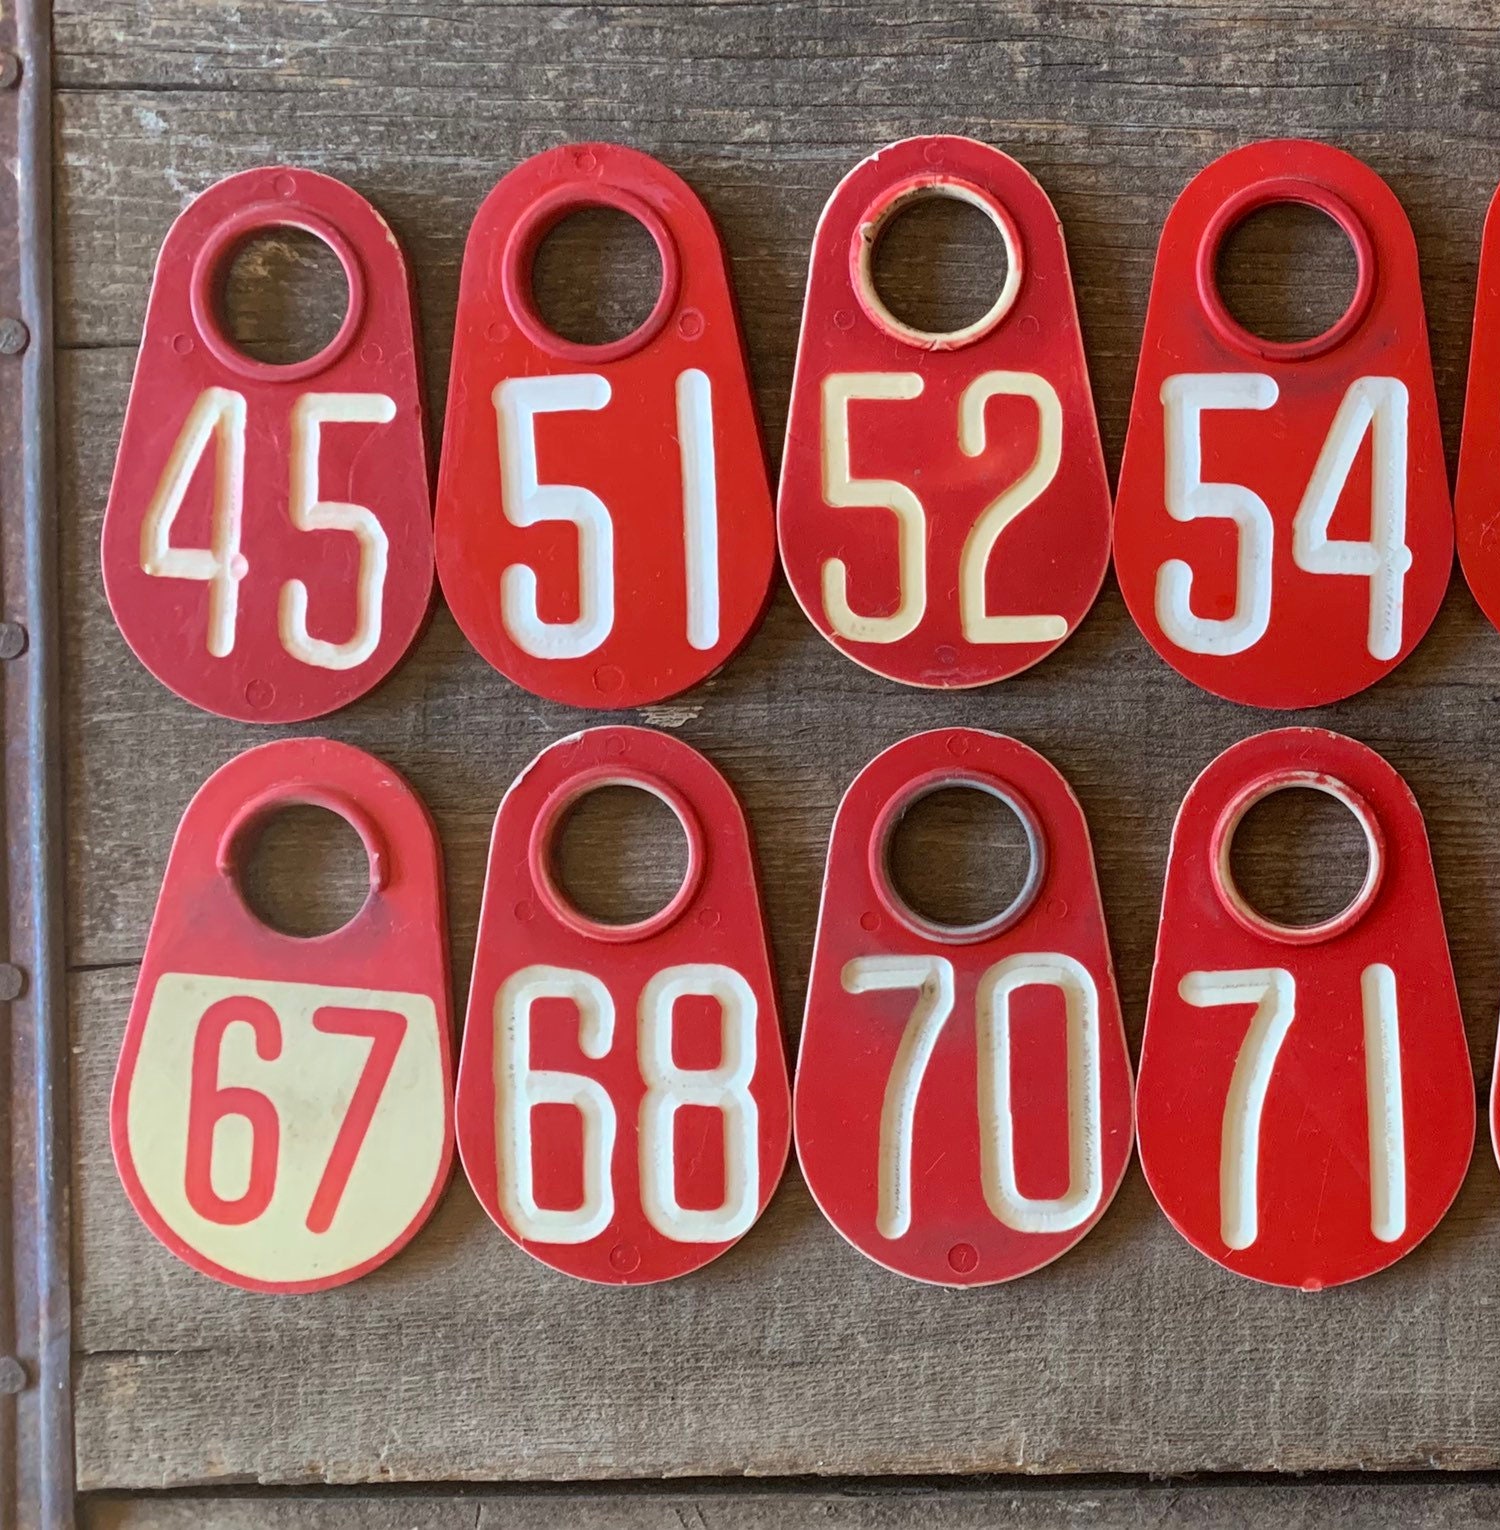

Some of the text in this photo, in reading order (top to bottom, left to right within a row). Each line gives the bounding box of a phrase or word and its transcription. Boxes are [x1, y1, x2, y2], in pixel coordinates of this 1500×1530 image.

[140, 386, 397, 671] 45
[491, 368, 720, 660] 51
[821, 370, 1068, 643] 52
[1154, 373, 1412, 661] 54
[184, 995, 408, 1234] 67
[493, 963, 758, 1244] 68
[841, 952, 1101, 1240] 70
[1178, 963, 1406, 1250] 71
